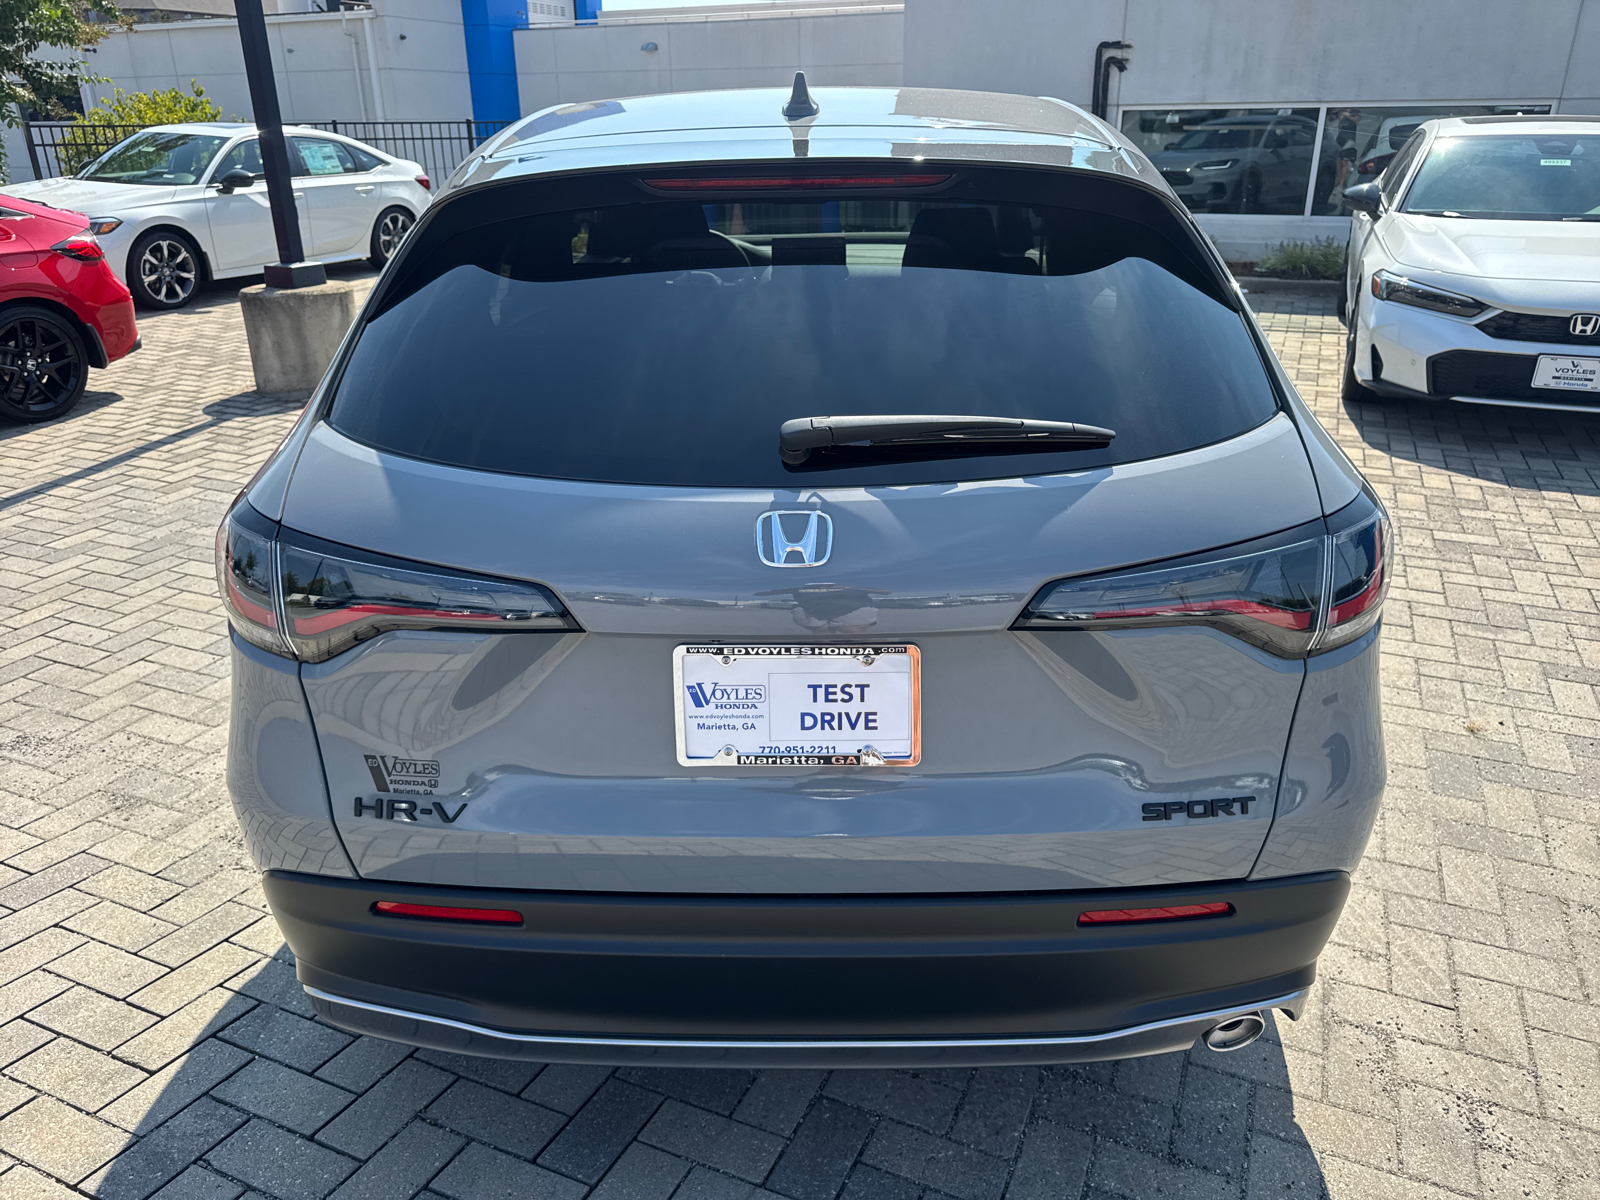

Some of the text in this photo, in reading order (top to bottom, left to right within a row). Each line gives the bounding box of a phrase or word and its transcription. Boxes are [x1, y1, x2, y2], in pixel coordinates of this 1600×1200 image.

[696, 682, 763, 706] VOYLES
[807, 683, 871, 703] TEST
[697, 722, 756, 731] Marietta, GA
[800, 711, 879, 731] DRIVE
[758, 745, 836, 754] 770-951-2211
[368, 755, 439, 778] ED VOYLES
[740, 755, 858, 765] Marietta, GA
[389, 778, 428, 786] HONDA
[392, 788, 422, 796] Marietta,
[354, 796, 468, 824] HR-V
[1141, 796, 1256, 822] SPORT
